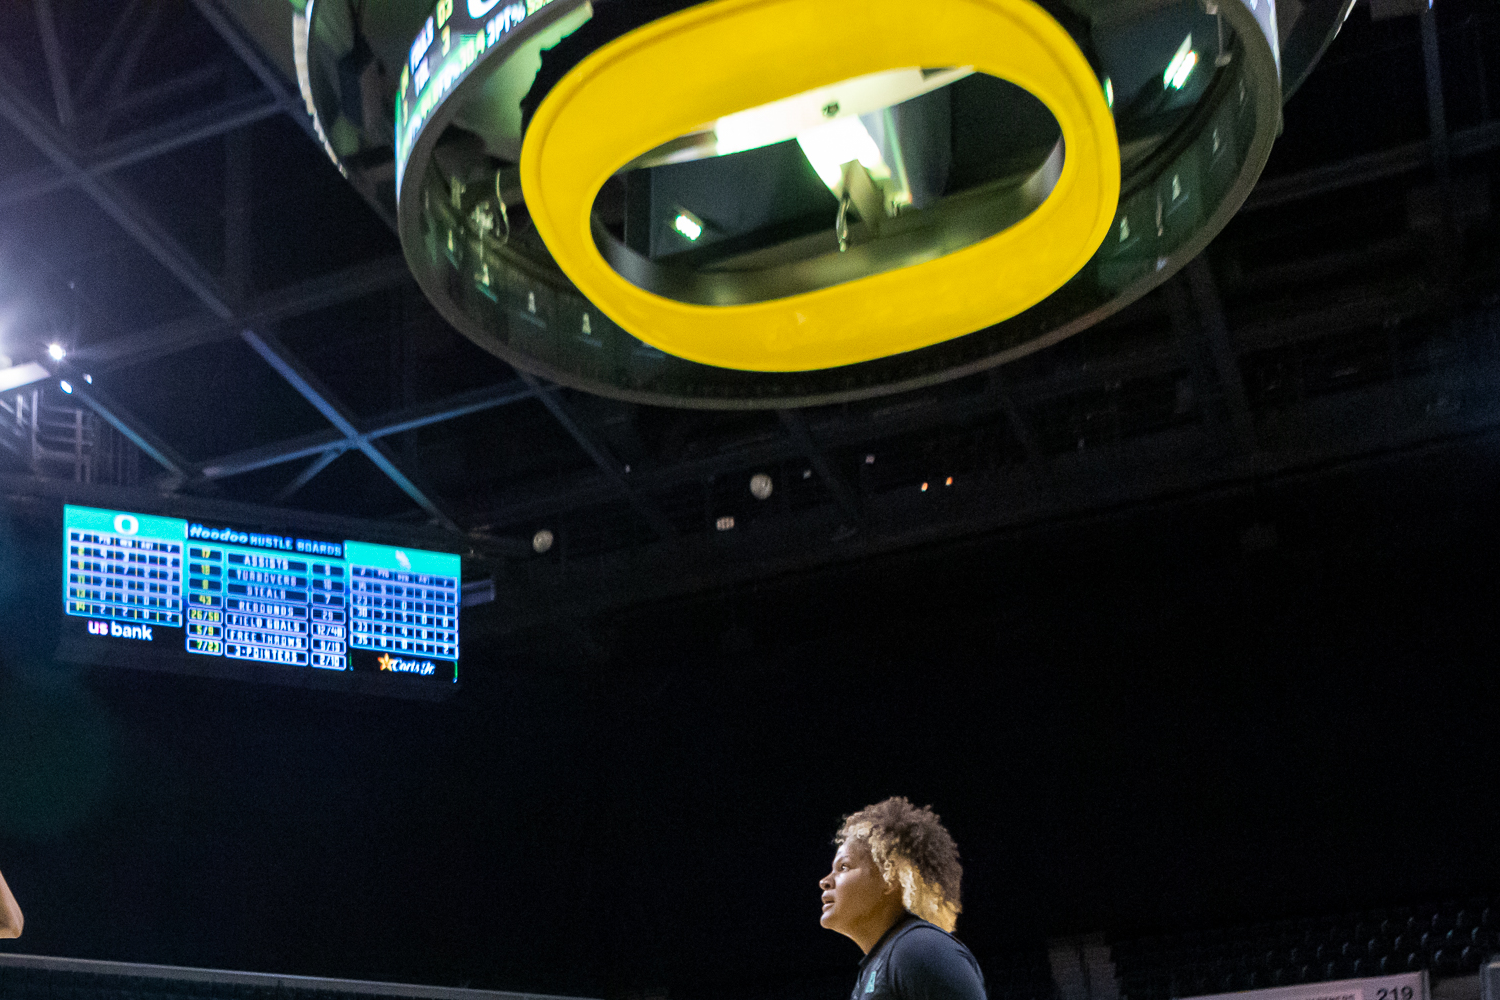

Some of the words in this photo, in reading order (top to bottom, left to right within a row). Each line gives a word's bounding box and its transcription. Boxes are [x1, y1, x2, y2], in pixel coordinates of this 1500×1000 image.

[190, 523, 248, 544] Hoodoo
[250, 533, 293, 550] HUSTLE
[237, 569, 297, 587] TURNOVERS
[239, 601, 294, 617] REBOUNDS
[111, 621, 152, 641] bank
[233, 615, 263, 627] FIELD
[267, 619, 300, 632] GOALS
[231, 630, 258, 643] FREE
[262, 634, 302, 648] THROWS
